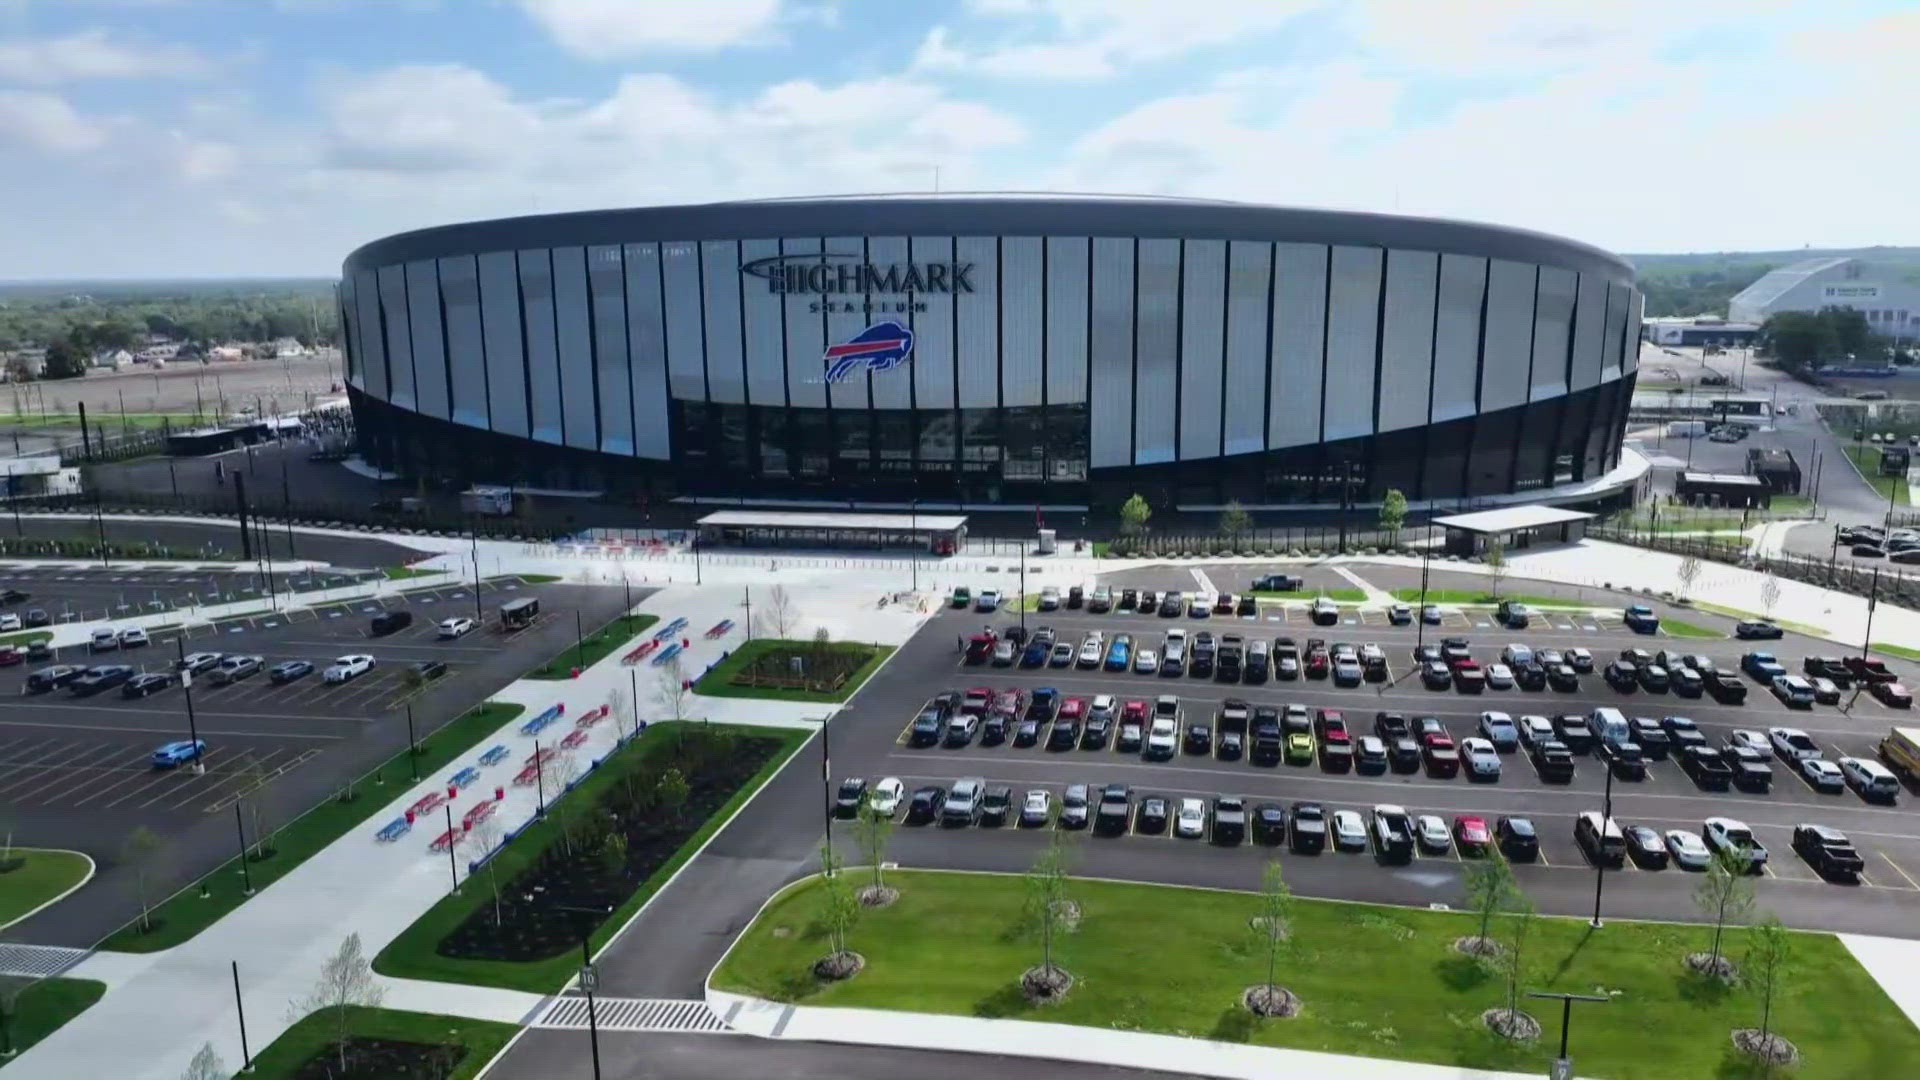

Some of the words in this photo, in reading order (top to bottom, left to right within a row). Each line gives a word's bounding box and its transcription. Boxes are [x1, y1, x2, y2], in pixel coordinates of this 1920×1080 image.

[769, 263, 974, 293] HIGHMARK
[809, 302, 928, 314] STADIUM
[583, 973, 595, 985] 10
